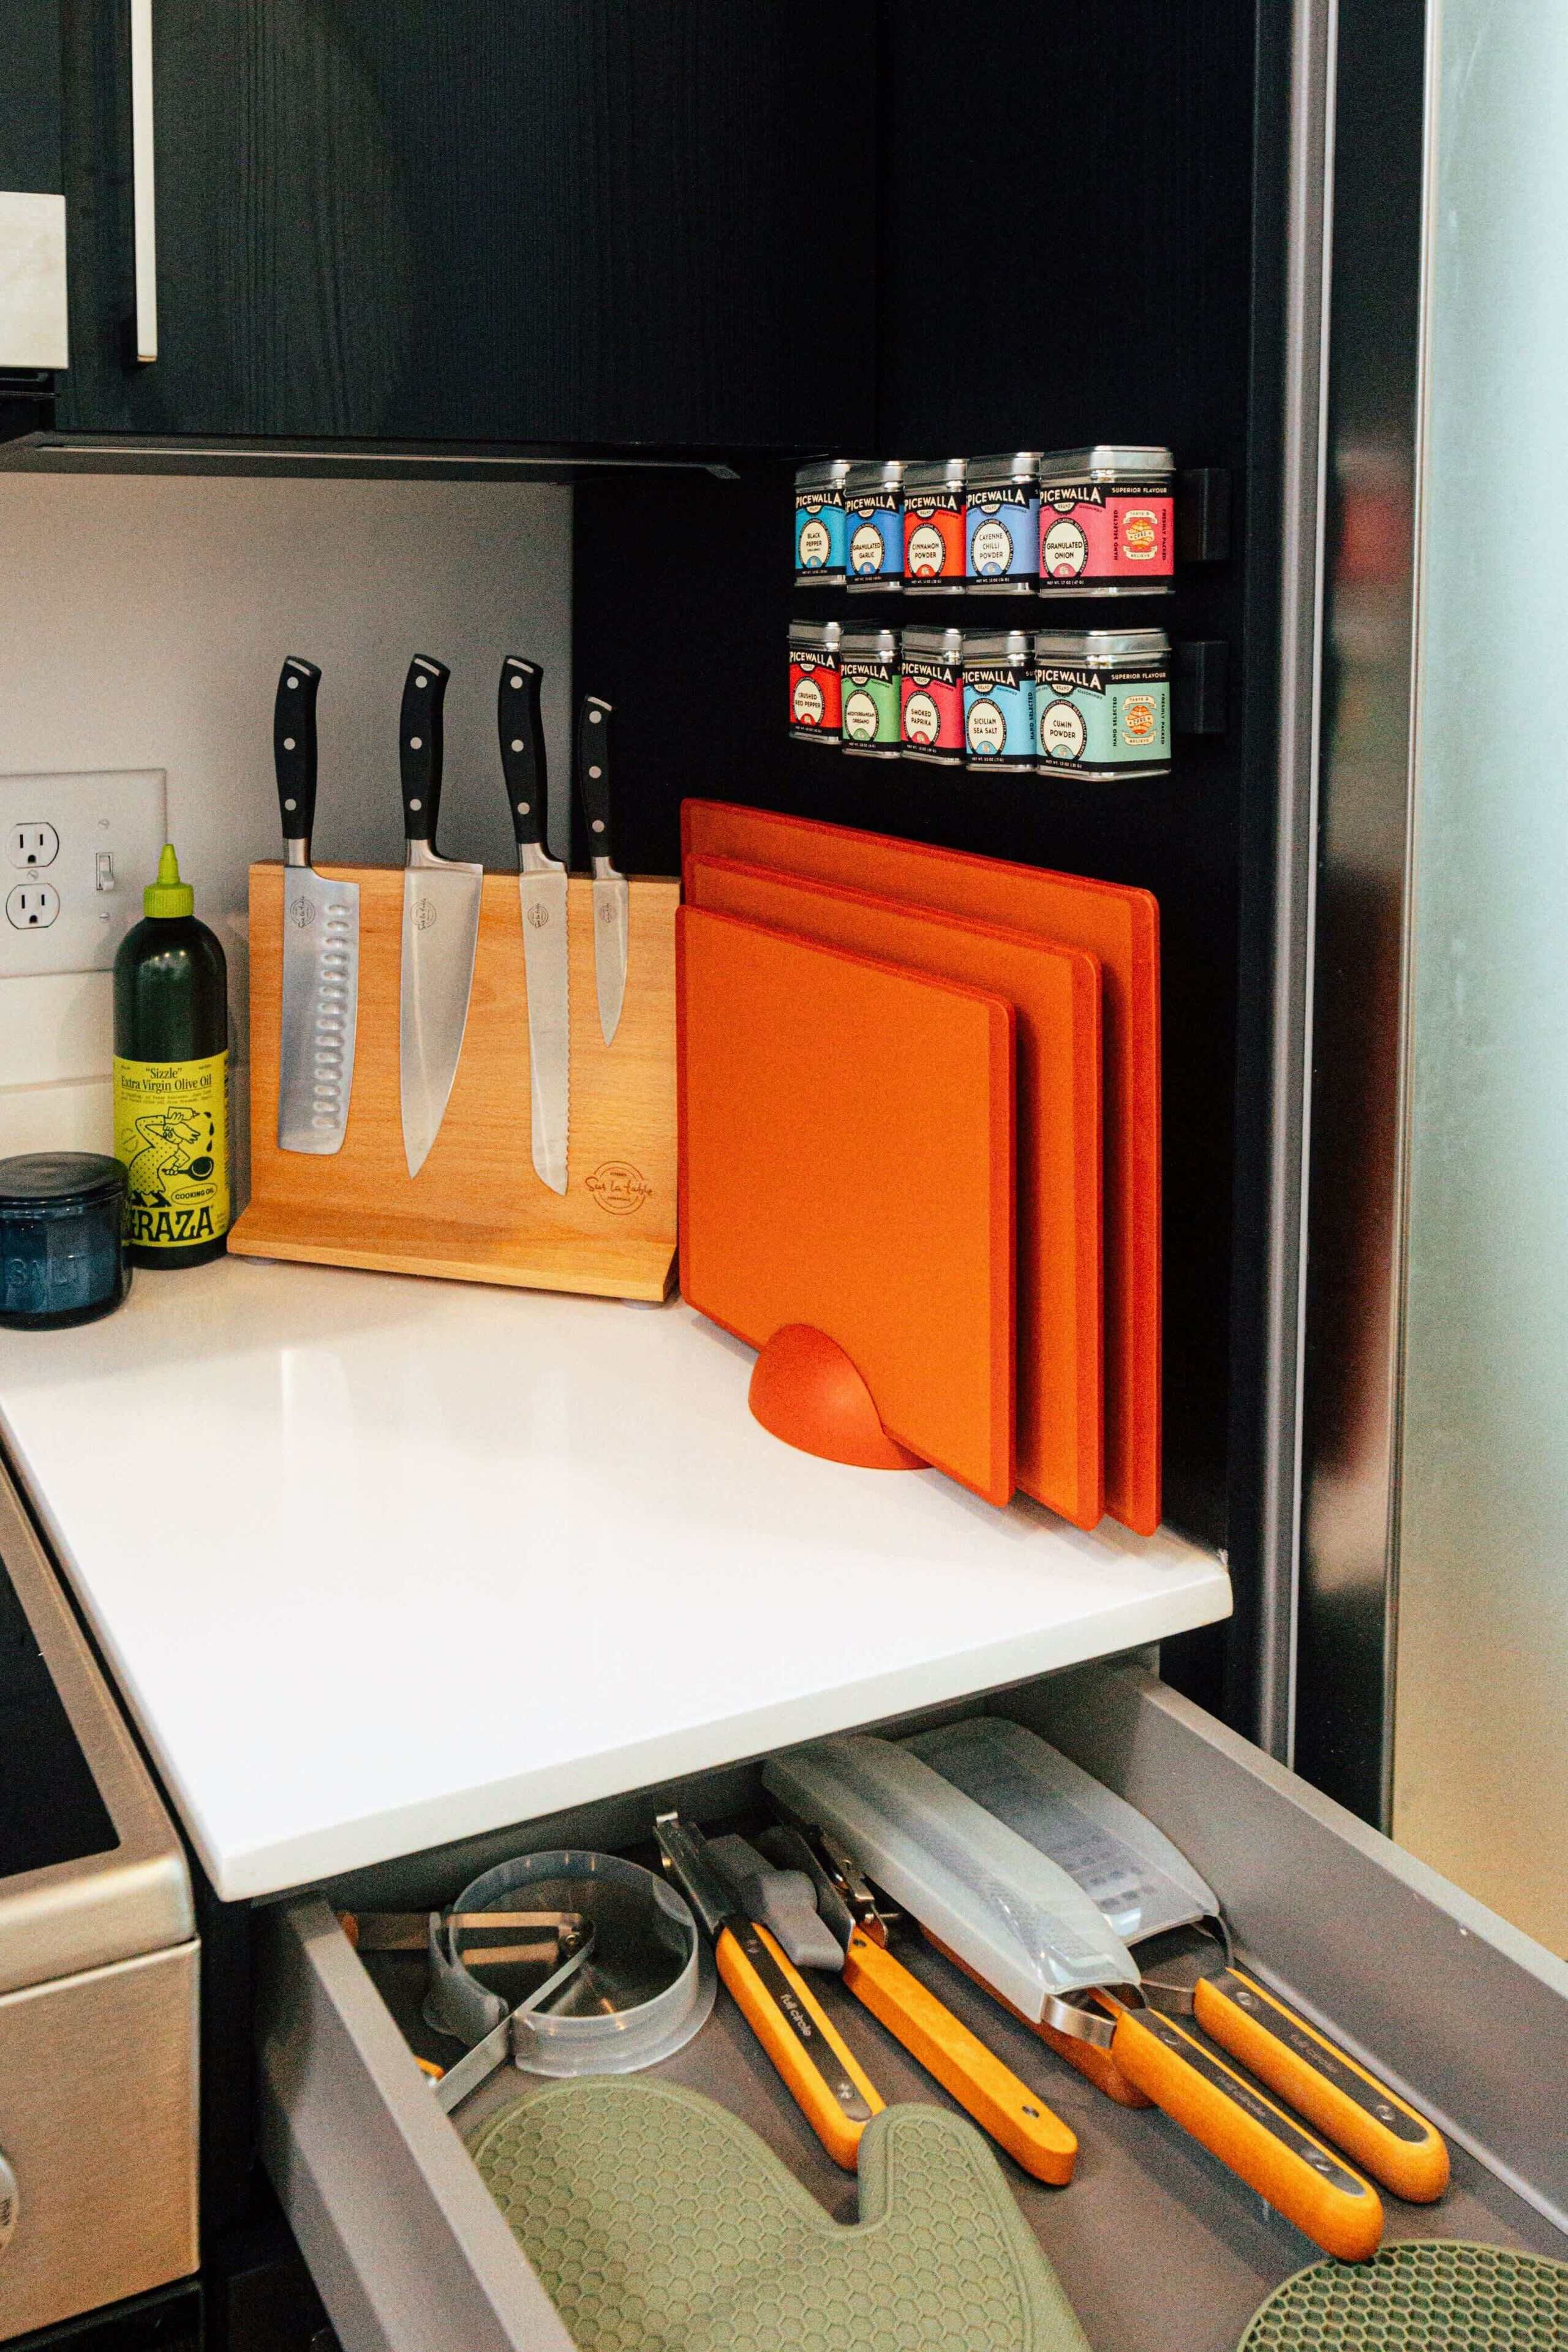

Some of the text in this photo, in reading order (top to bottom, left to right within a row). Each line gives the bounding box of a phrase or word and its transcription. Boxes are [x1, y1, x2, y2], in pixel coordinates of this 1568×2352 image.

[966, 489, 1026, 509] PICEWALLA
[845, 496, 895, 514] PICEWALLA
[911, 709, 931, 717] SMOKED
[911, 717, 931, 726] PAPRIKA
[1050, 729, 1076, 739] POWDER
[122, 1074, 211, 1093] Extra Virgin Olive Oil
[175, 1191, 205, 1200] COOKING
